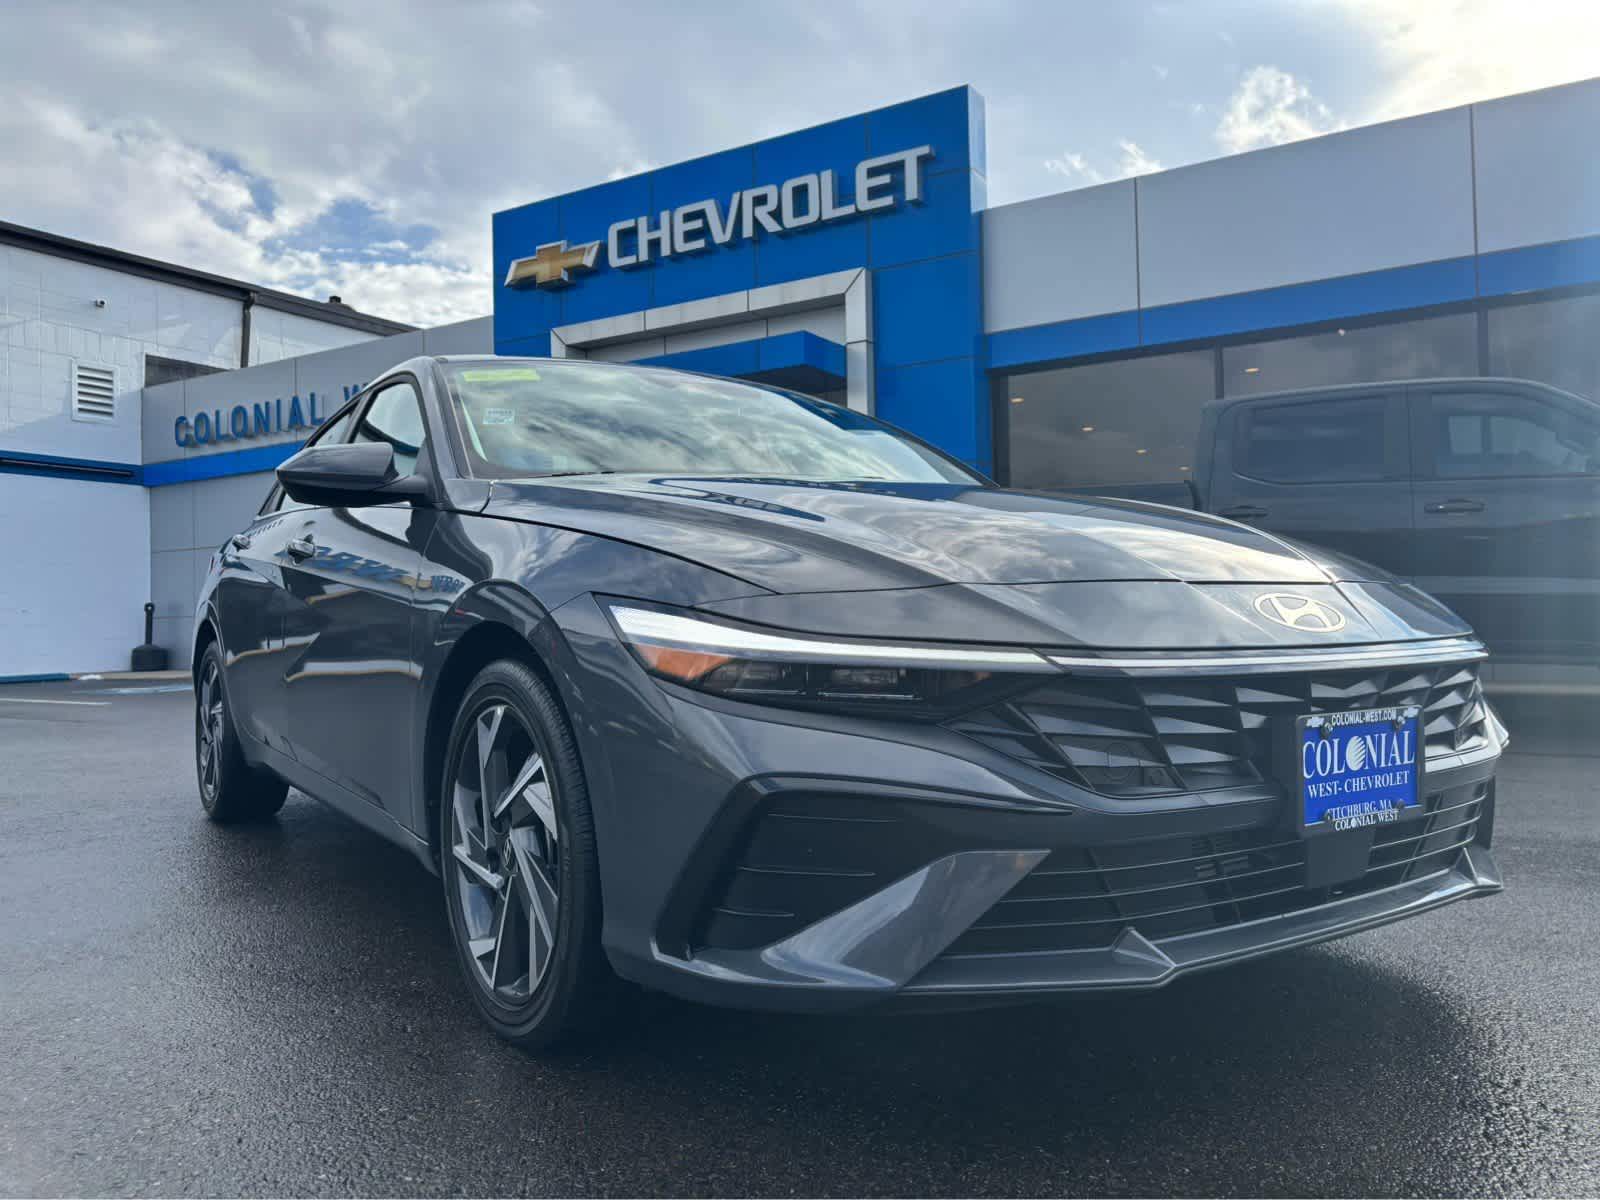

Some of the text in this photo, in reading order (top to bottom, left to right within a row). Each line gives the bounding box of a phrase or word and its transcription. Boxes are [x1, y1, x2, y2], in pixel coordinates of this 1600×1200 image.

[607, 145, 932, 269] CHEVROLET
[174, 392, 325, 447] COLONIAL
[1331, 709, 1397, 726] COLONIAL-WEST.COM
[1302, 731, 1415, 779] COLONIAL
[1335, 810, 1399, 831] COLONIAL WEST
[1379, 799, 1393, 810] MA
